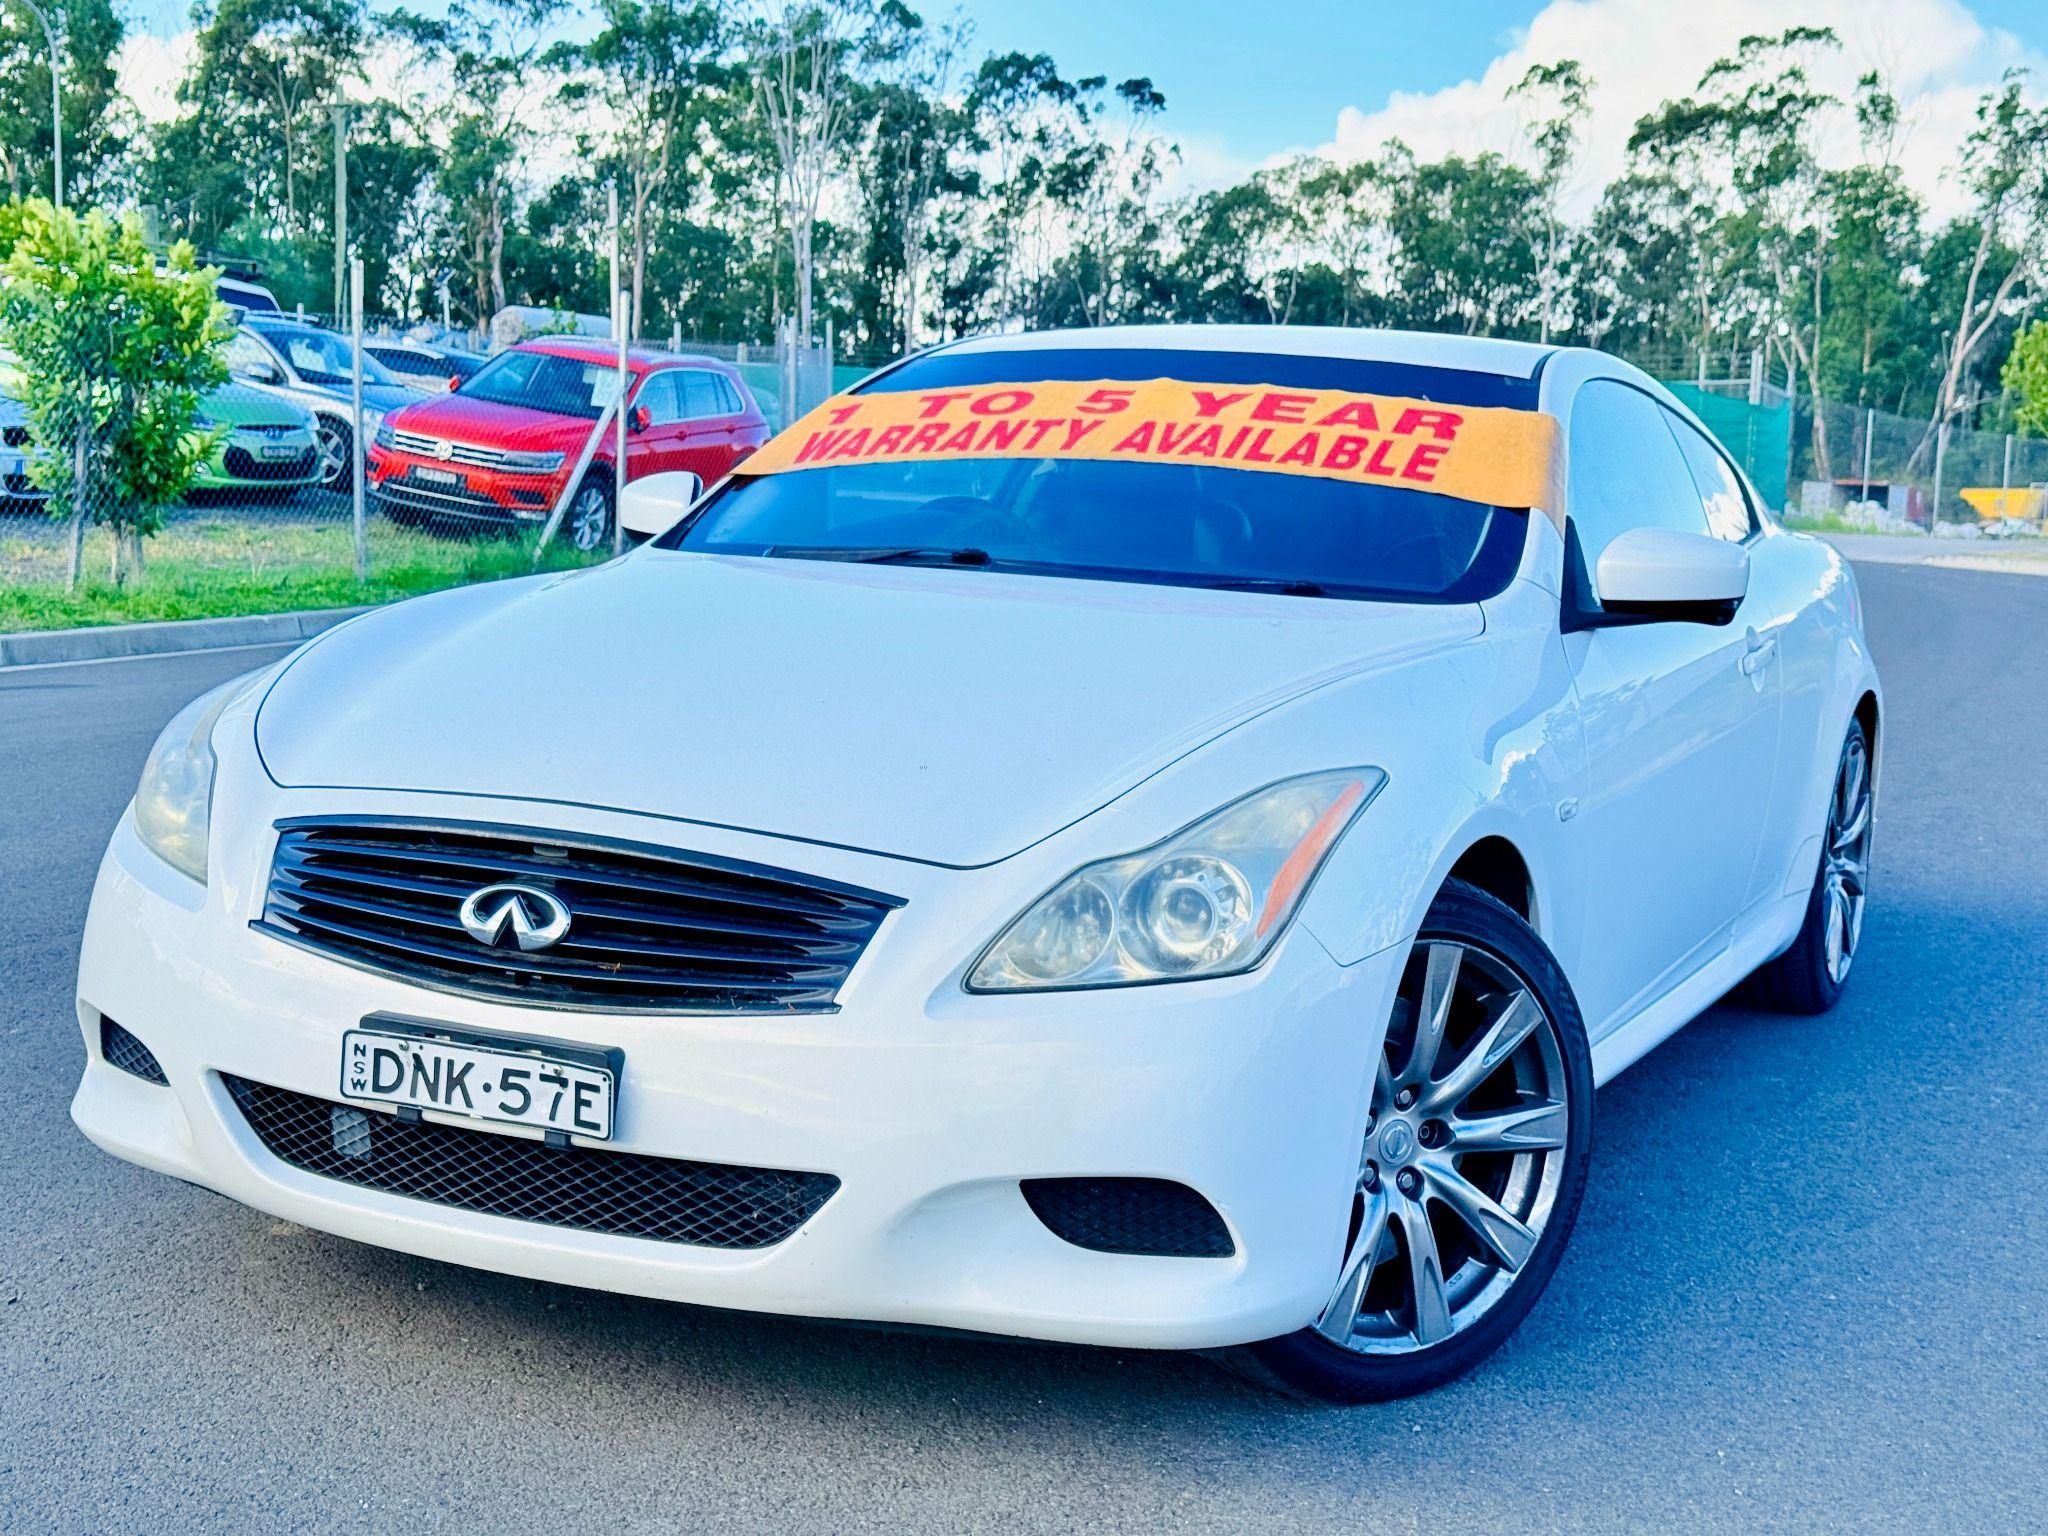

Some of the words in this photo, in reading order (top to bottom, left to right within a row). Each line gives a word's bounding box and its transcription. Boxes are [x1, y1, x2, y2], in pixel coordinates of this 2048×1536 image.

[829, 403, 863, 424] 1
[919, 391, 1035, 419] TO
[1077, 390, 1136, 414] 5
[1192, 391, 1464, 441] YEAR
[793, 419, 1106, 463] WARRANTY
[1111, 421, 1450, 483] AVAILABLE
